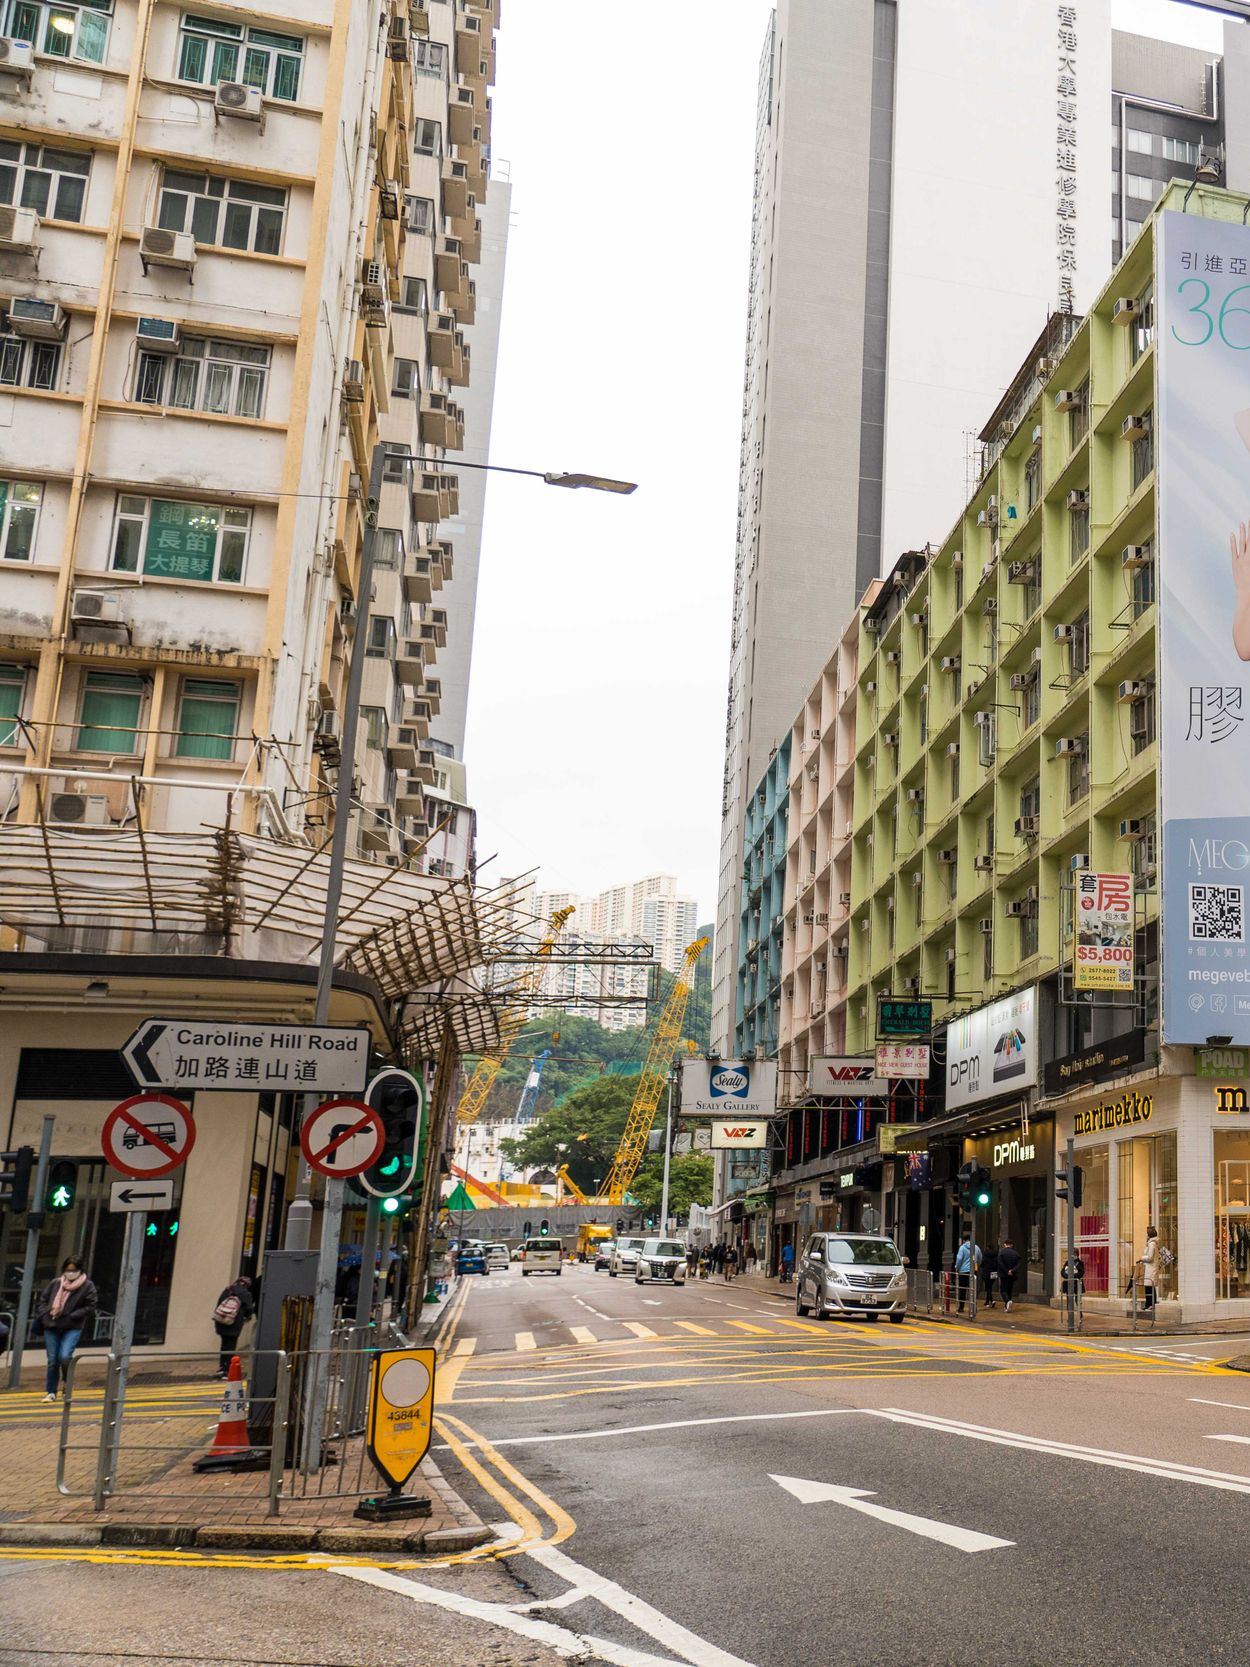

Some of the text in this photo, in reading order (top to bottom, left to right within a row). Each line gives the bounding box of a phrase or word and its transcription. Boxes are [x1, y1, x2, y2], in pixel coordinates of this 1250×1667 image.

[157, 529, 210, 553] 長笛
[150, 553, 210, 575] 大提琴
[1077, 946, 1132, 963] $5,800
[176, 1029, 358, 1051] Caroline Hill Road
[175, 1055, 318, 1082] 加路連山道
[1200, 1049, 1245, 1069] POAD
[714, 1074, 742, 1089] Sealy
[950, 1054, 980, 1087] DPM
[695, 1100, 760, 1111] SEALY GALLERY
[1073, 1091, 1153, 1136] marimekko
[993, 1140, 1020, 1167] DPM
[387, 1409, 421, 1421] 43844
